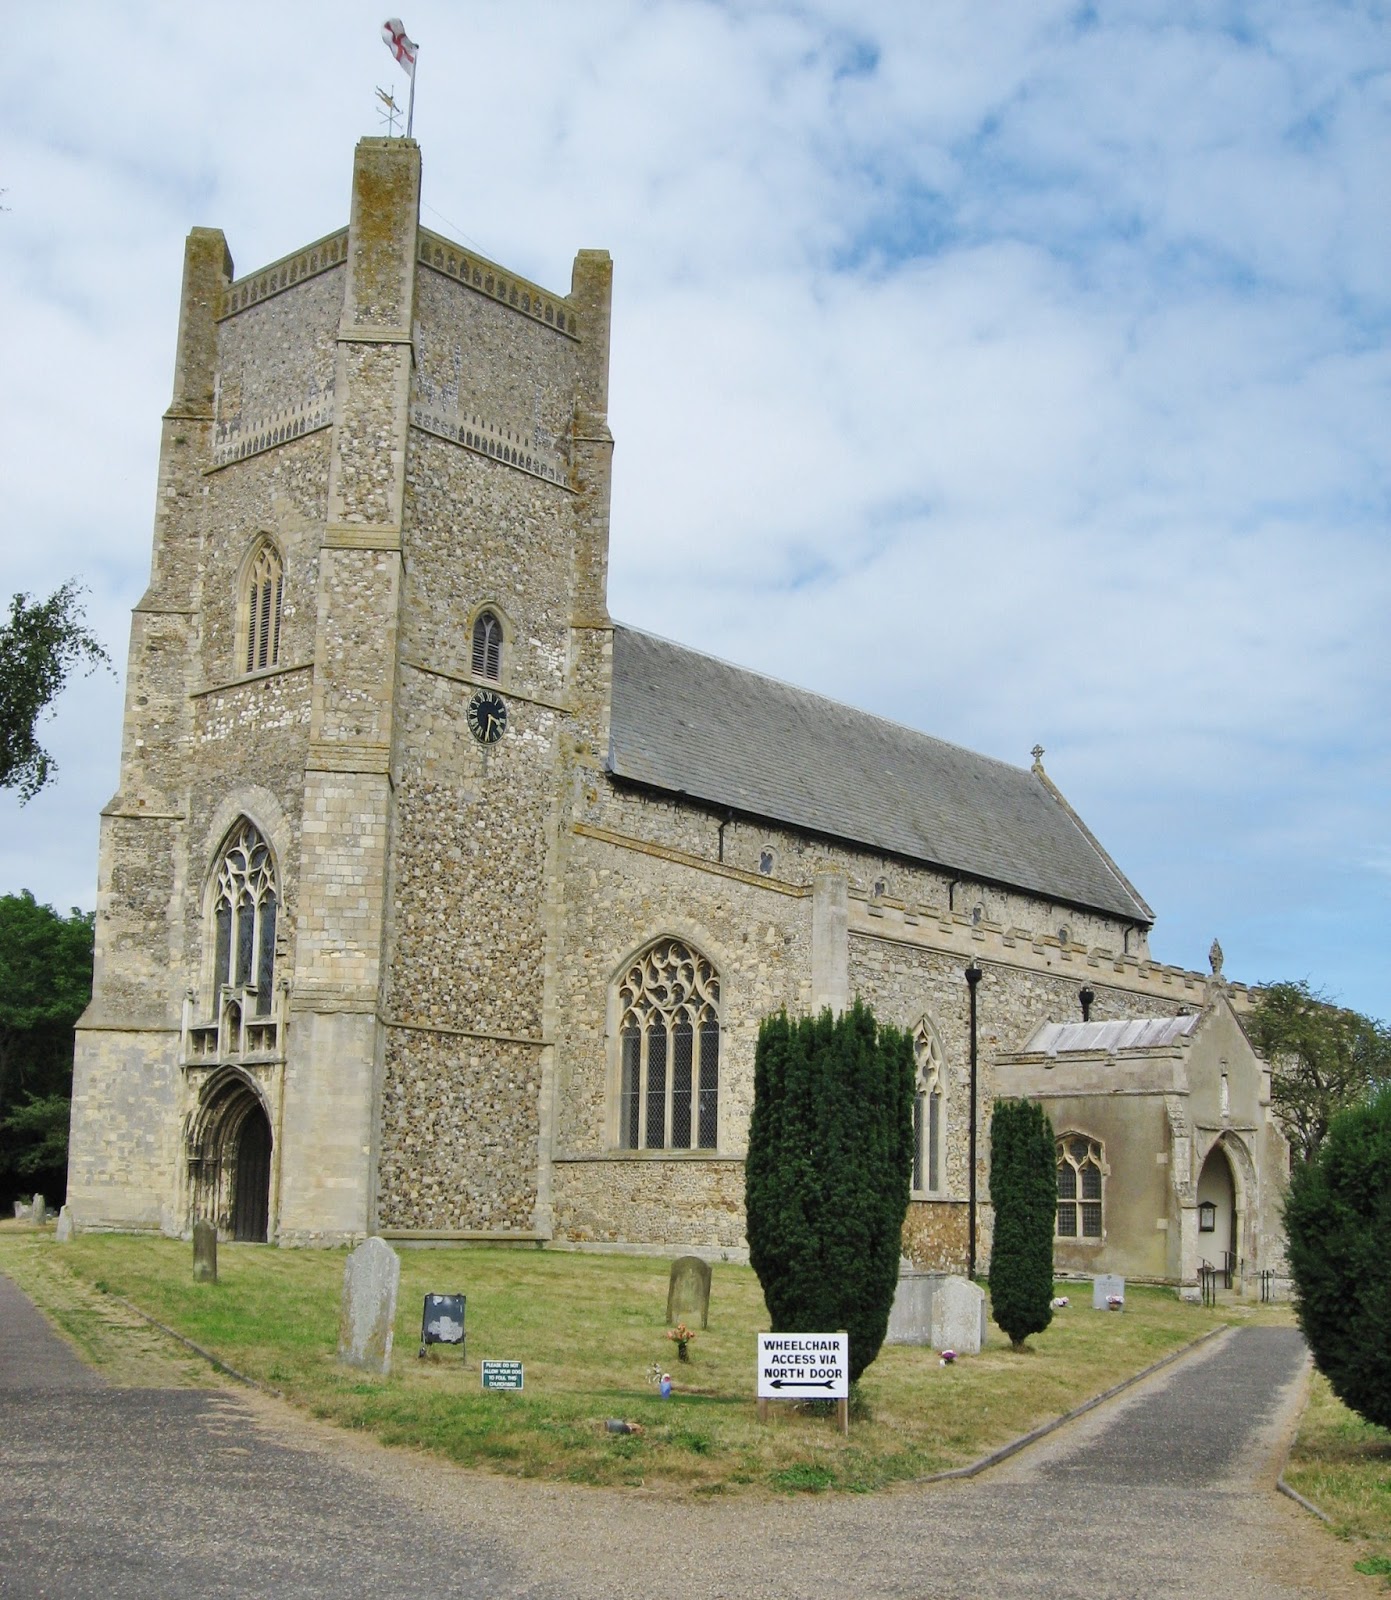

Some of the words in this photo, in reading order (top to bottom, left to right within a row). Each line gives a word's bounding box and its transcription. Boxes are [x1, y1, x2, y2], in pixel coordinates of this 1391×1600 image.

[764, 1341, 840, 1351] WHEELCHAIR
[771, 1354, 816, 1364] ACCESS
[819, 1355, 837, 1364] VIA
[764, 1368, 804, 1378] NORTH
[810, 1369, 842, 1378] DOOR
